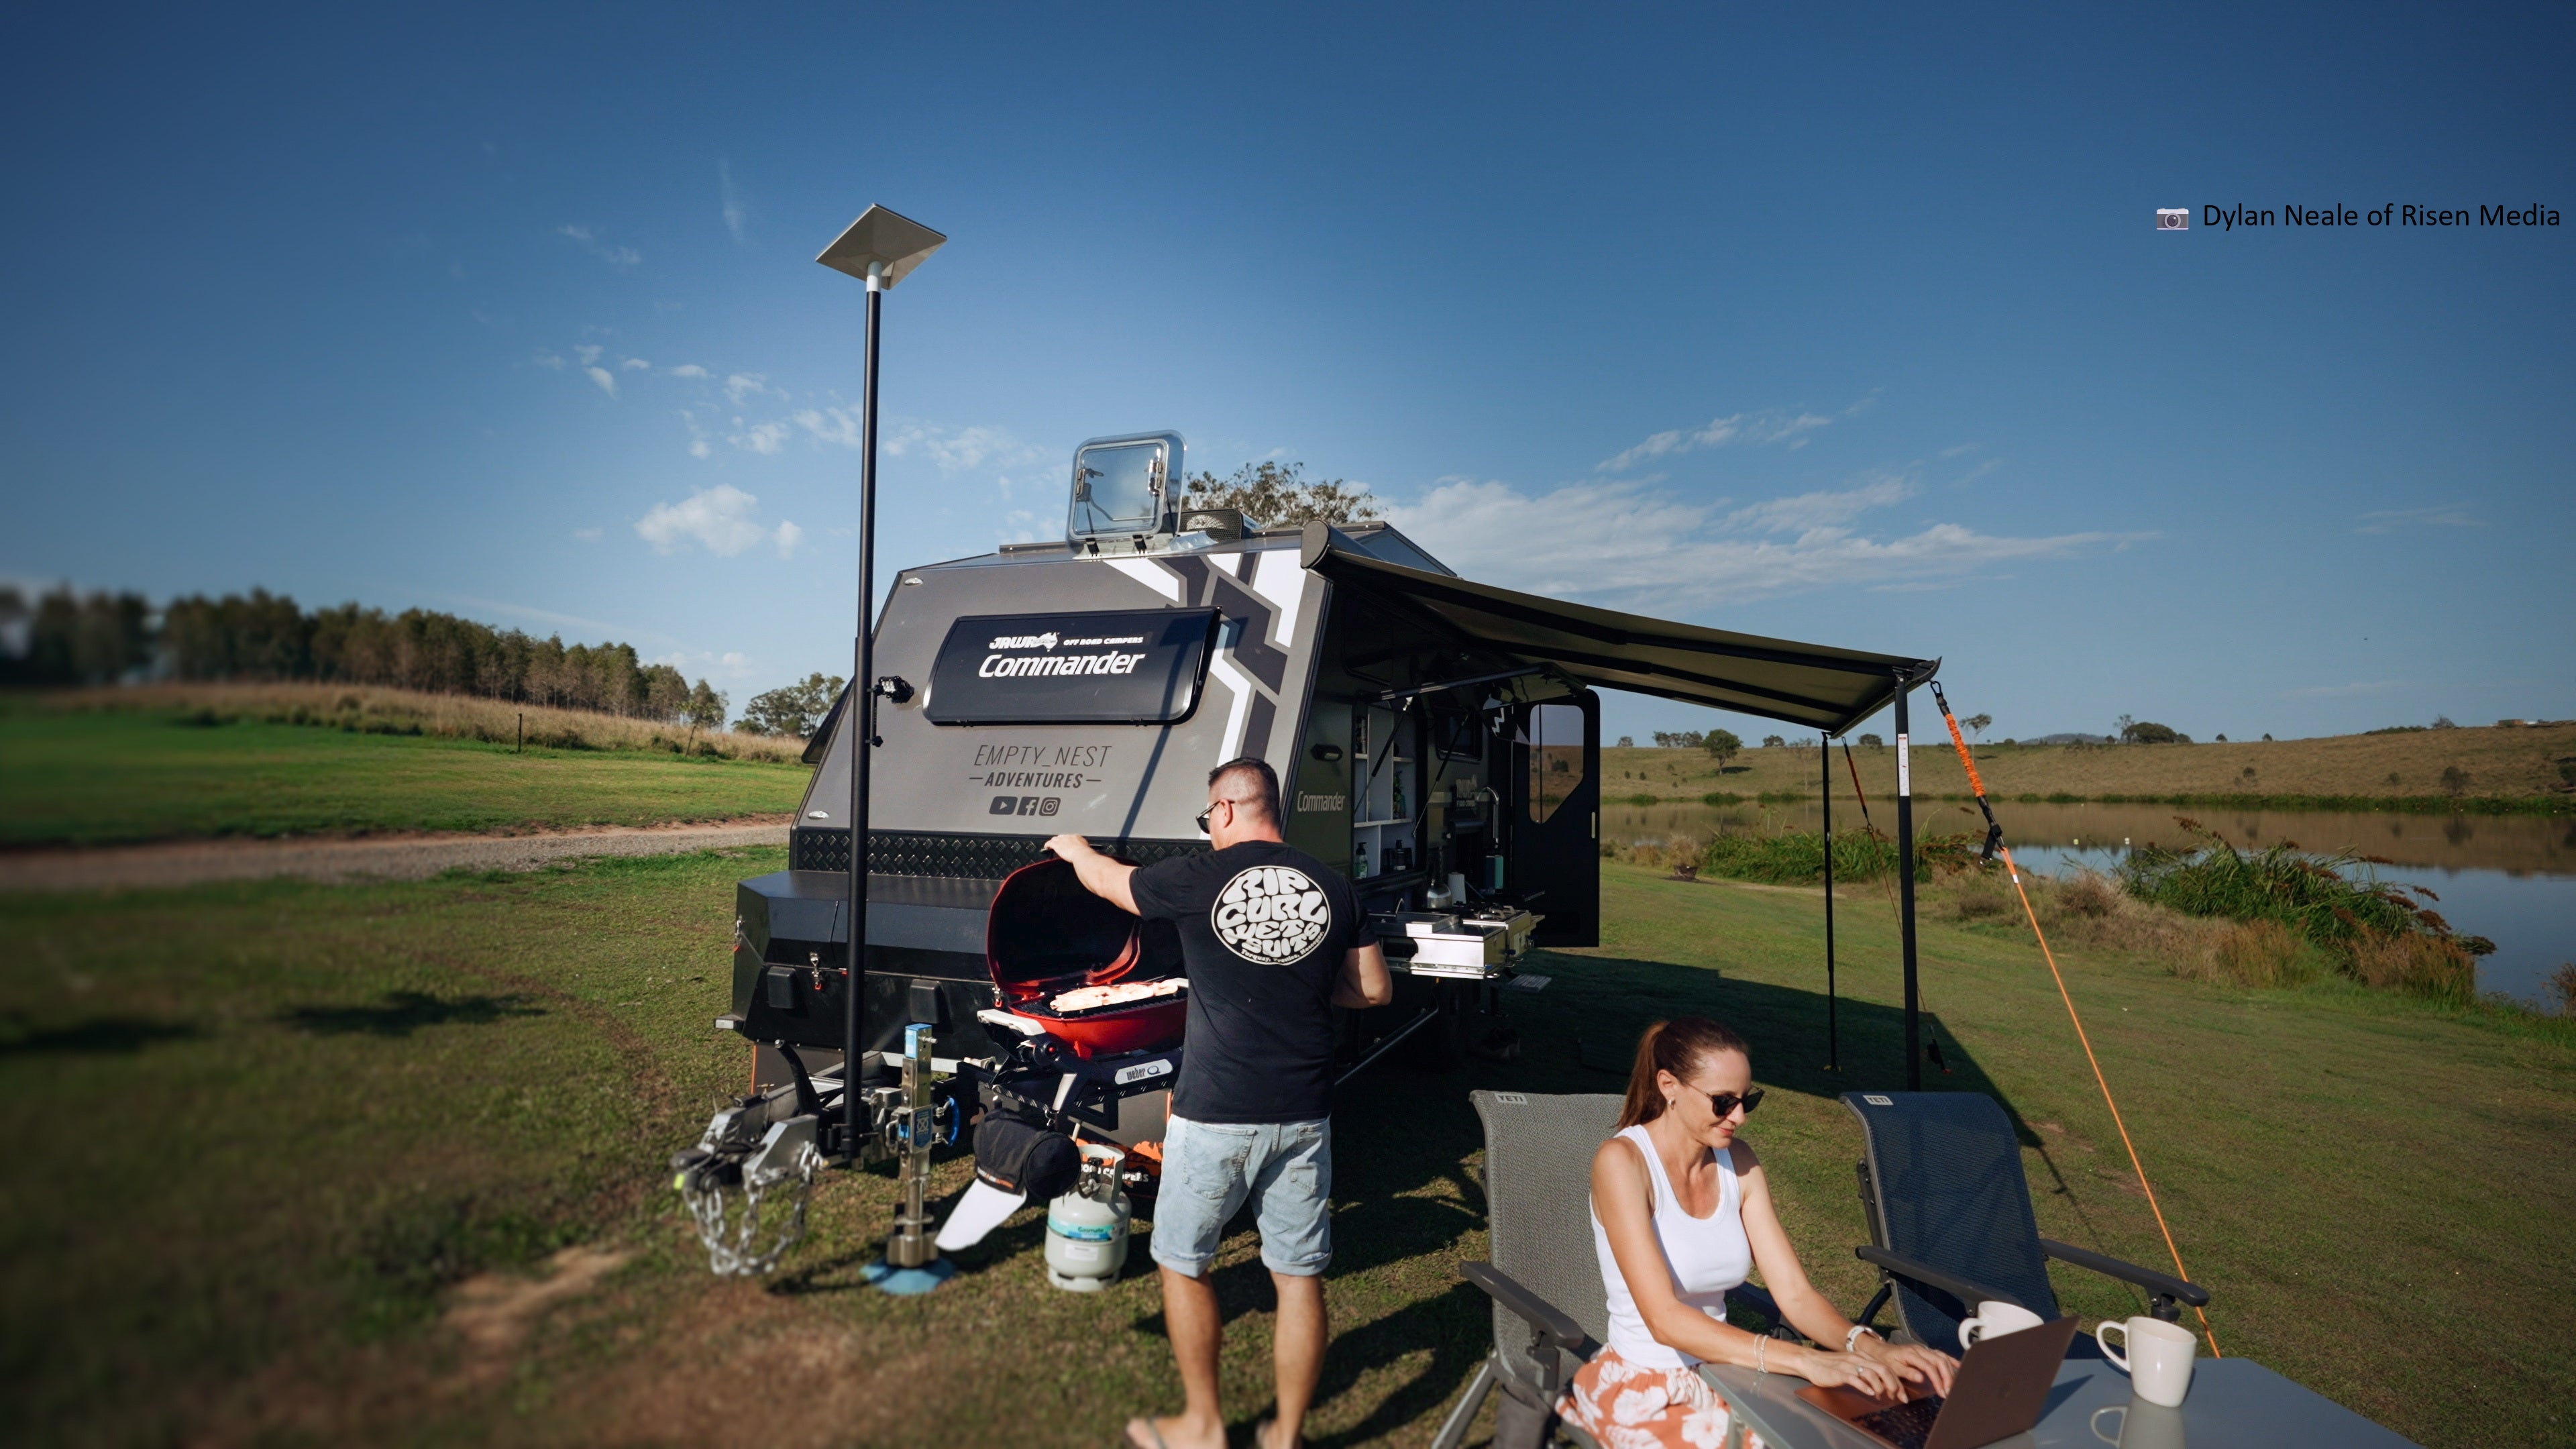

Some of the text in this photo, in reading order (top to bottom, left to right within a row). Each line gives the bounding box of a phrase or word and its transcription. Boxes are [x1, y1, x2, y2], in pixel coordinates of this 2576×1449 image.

[1103, 637, 1144, 645] CAMPERS
[978, 650, 1146, 678] Commander
[984, 772, 1083, 788] ADVENTURES
[1297, 790, 1346, 812] Commander
[1222, 868, 1309, 904] RIP
[1217, 891, 1328, 930] CURL
[1127, 1065, 1161, 1081] weber Q
